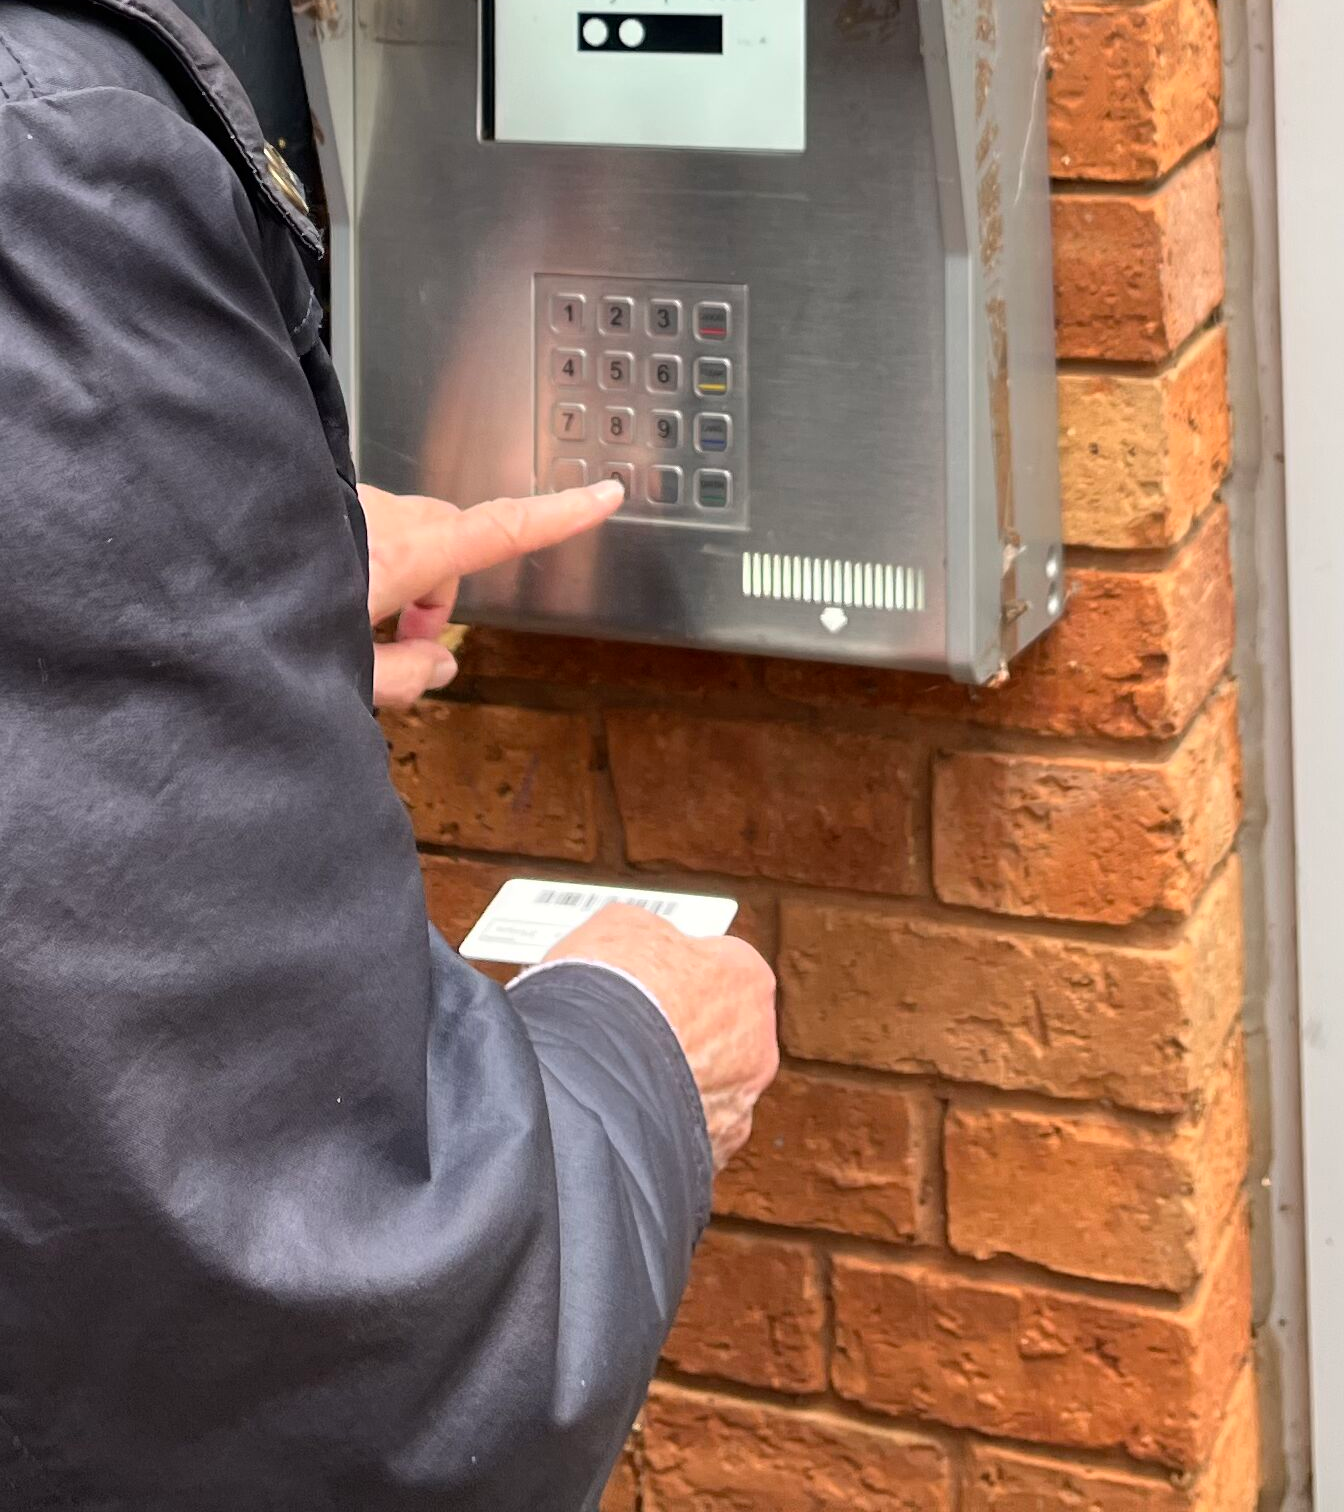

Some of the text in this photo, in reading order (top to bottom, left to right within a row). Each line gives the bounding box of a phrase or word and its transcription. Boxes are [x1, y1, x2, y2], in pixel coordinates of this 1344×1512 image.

[563, 305, 670, 328] 1 2 3
[562, 359, 669, 383] 4 5 6
[562, 413, 670, 438] 7 8 9
